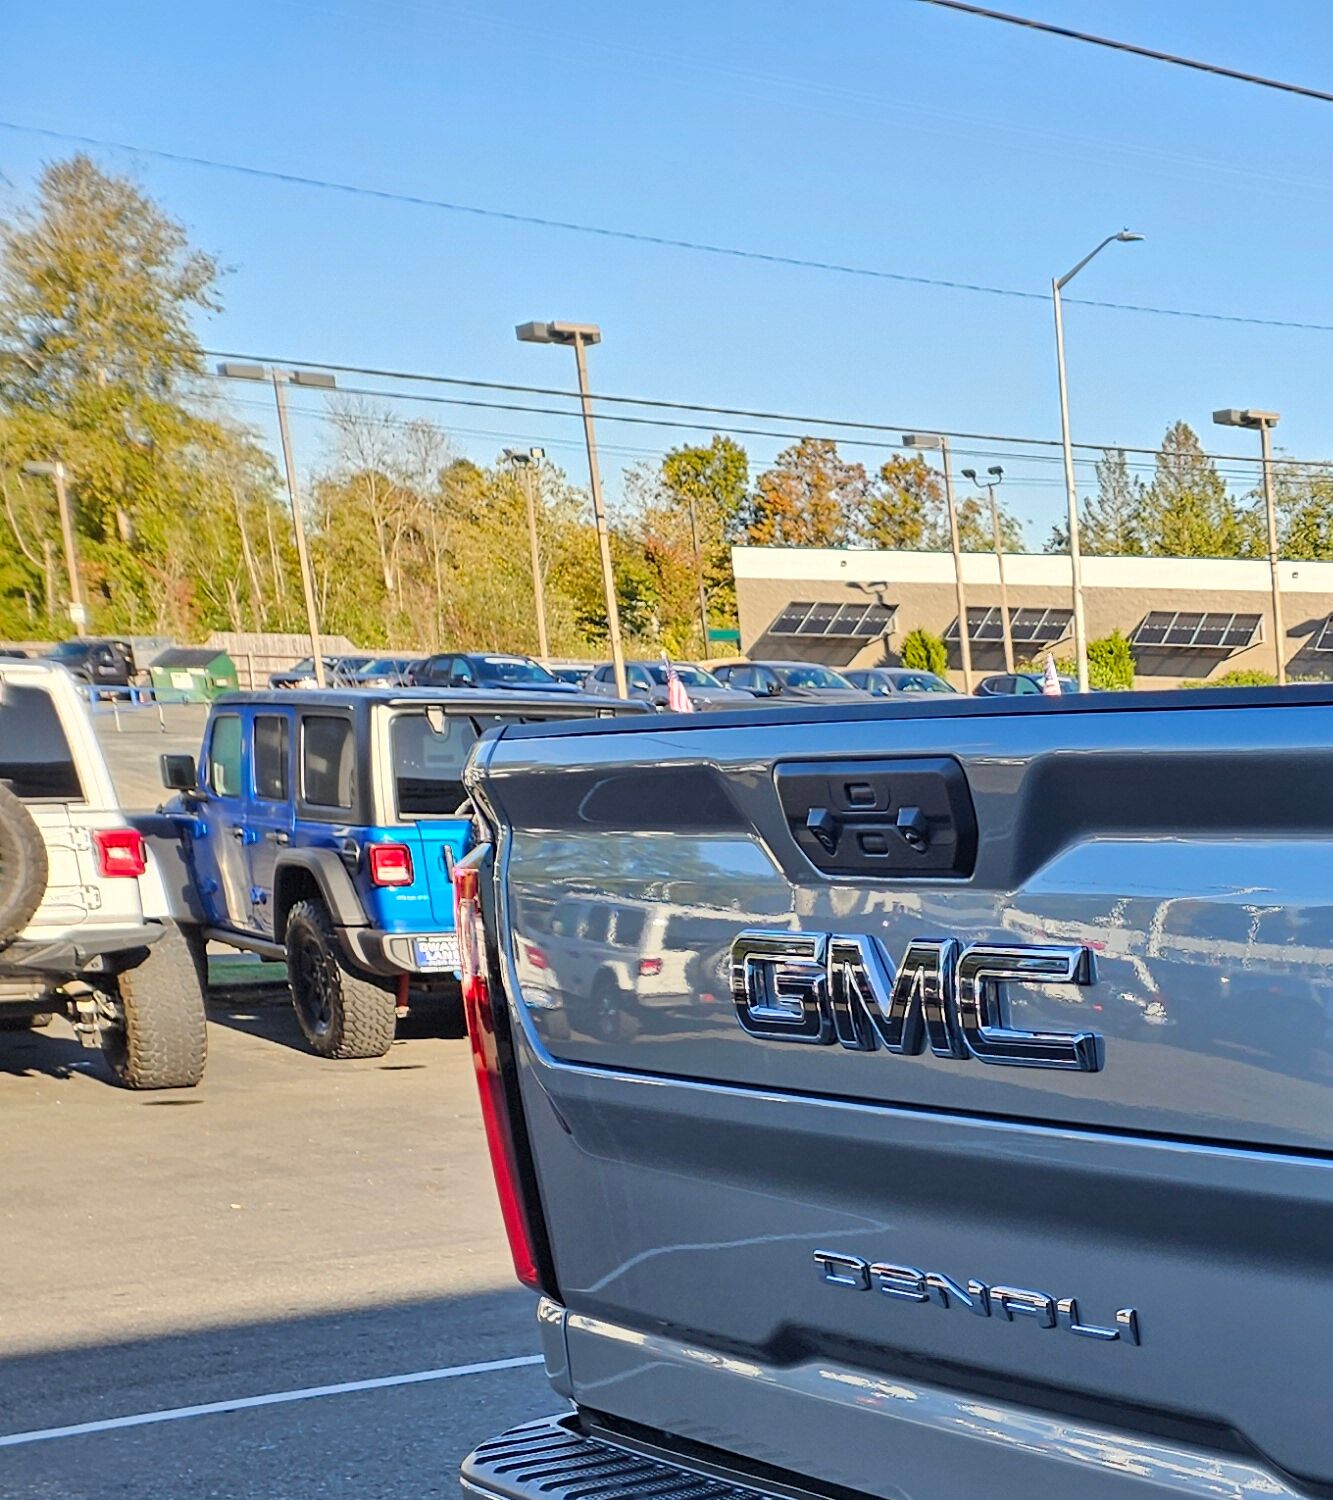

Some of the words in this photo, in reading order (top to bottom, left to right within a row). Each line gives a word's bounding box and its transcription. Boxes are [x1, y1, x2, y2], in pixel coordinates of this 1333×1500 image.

[419, 941, 459, 953] DWAY
[729, 929, 1104, 1072] GMC
[812, 1249, 1141, 1346] DENALI
